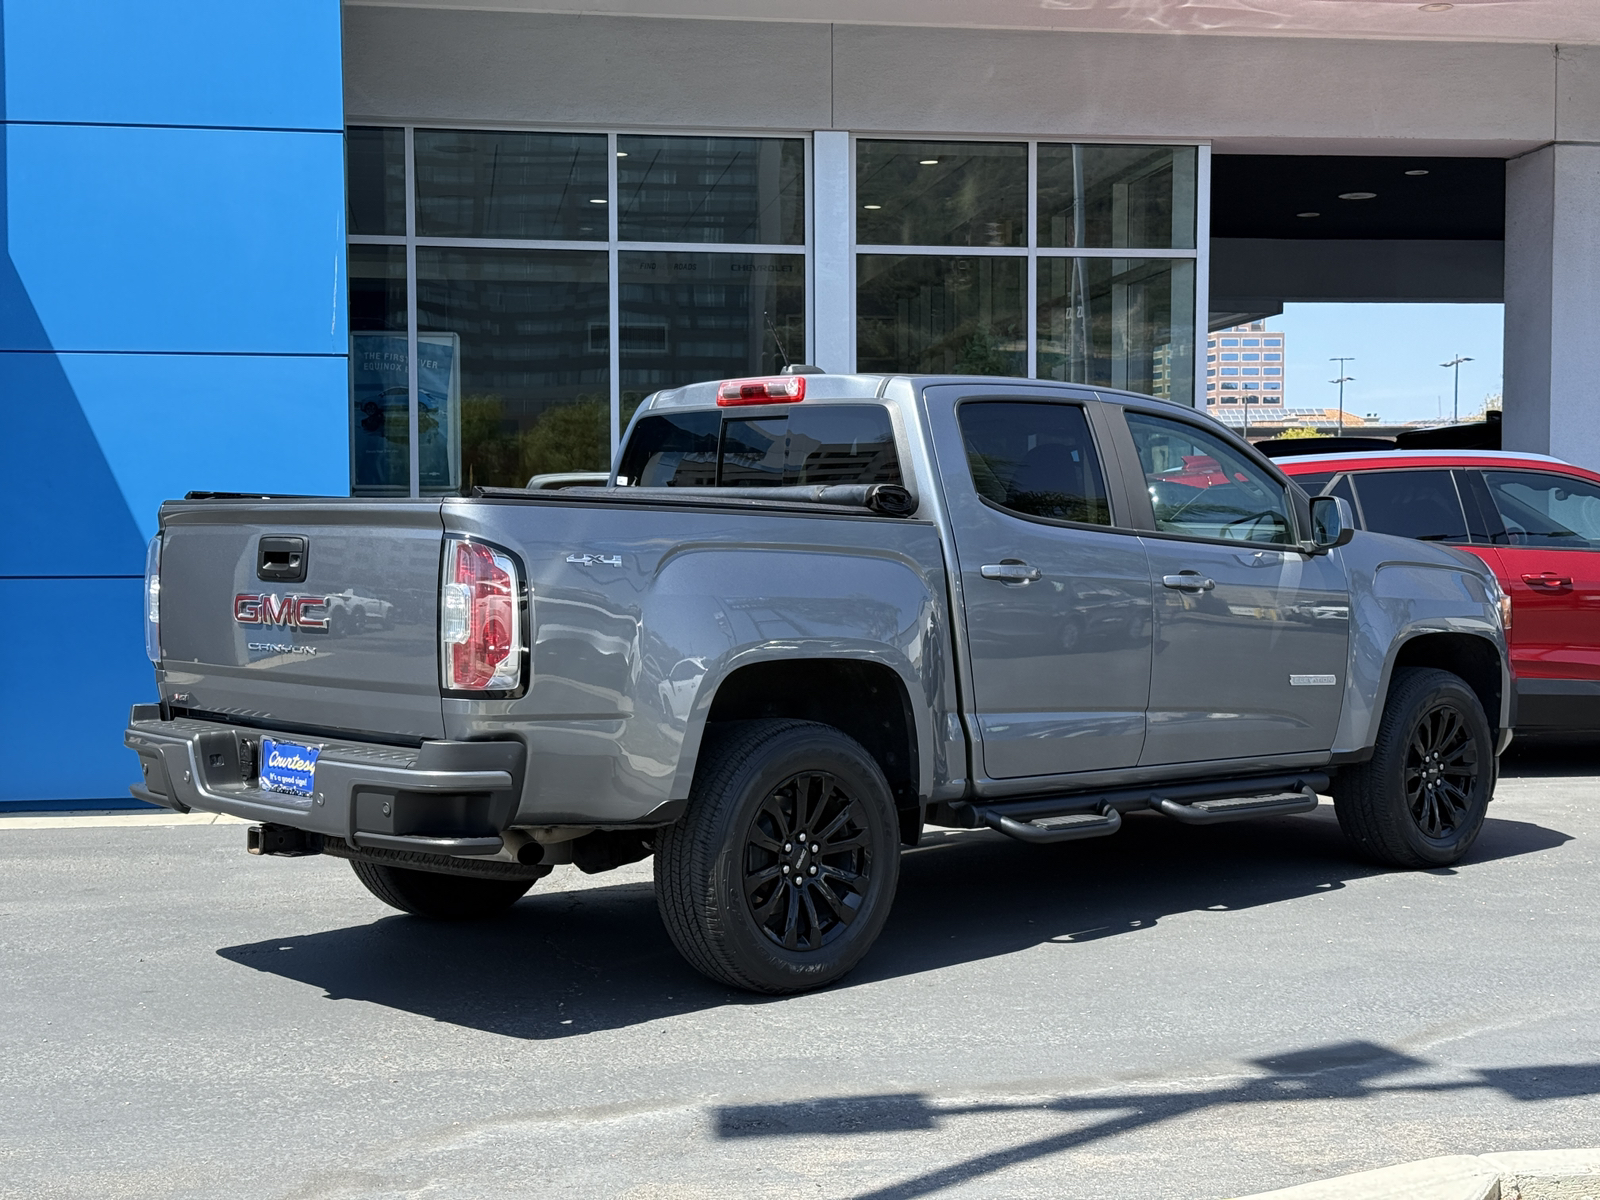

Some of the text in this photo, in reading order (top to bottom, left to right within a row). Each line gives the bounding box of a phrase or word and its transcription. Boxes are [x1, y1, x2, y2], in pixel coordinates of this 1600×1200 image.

[639, 262, 656, 270] FIND
[673, 263, 697, 271] ROADS
[730, 264, 794, 272] CHEVROLET
[363, 351, 381, 360] THE
[363, 362, 402, 372] EQUINOX
[233, 593, 331, 629] GMC
[248, 642, 317, 656] CANYON
[268, 751, 315, 776] Courtesy
[281, 775, 295, 784] good
